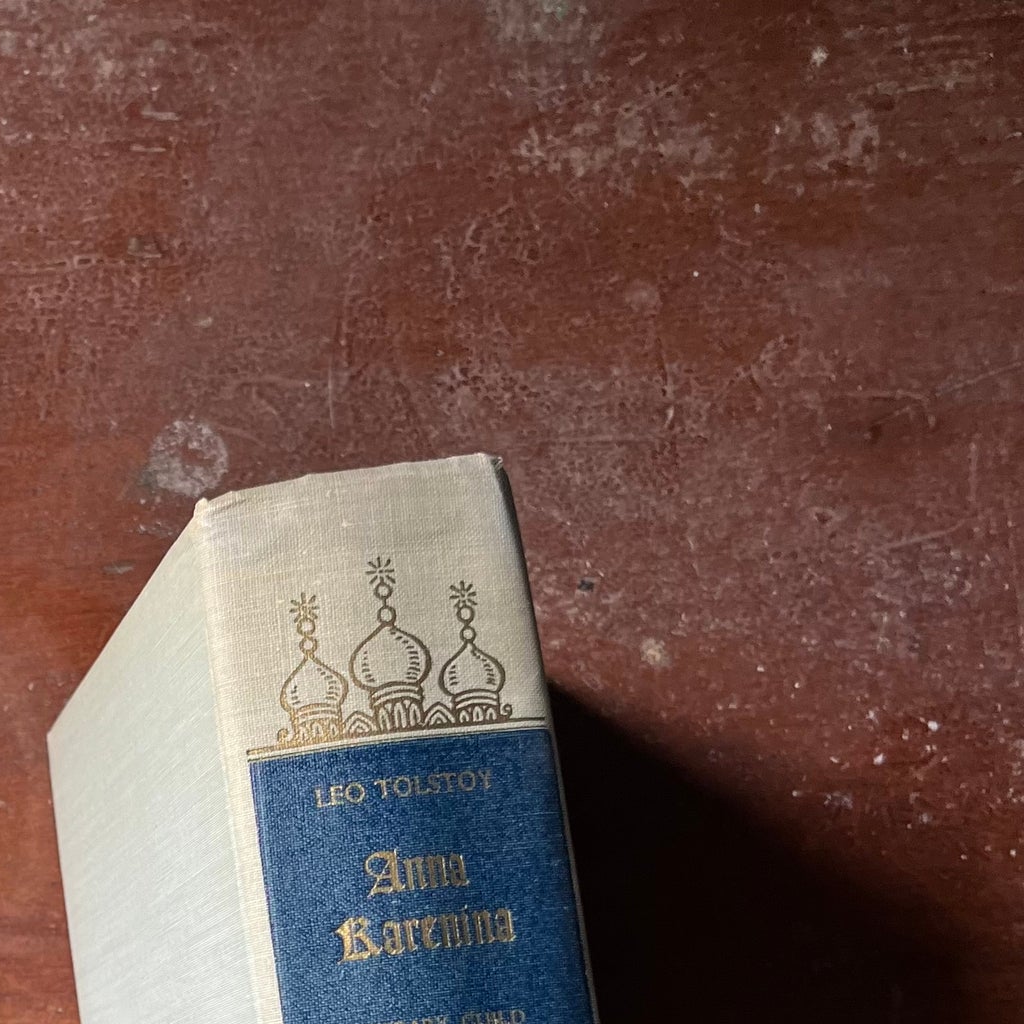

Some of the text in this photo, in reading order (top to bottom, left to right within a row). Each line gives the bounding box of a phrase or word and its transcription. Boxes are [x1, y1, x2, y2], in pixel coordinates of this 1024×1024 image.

[315, 769, 491, 808] LEO TOLSTOY
[364, 849, 469, 898] Anna
[334, 905, 516, 965] Karenina
